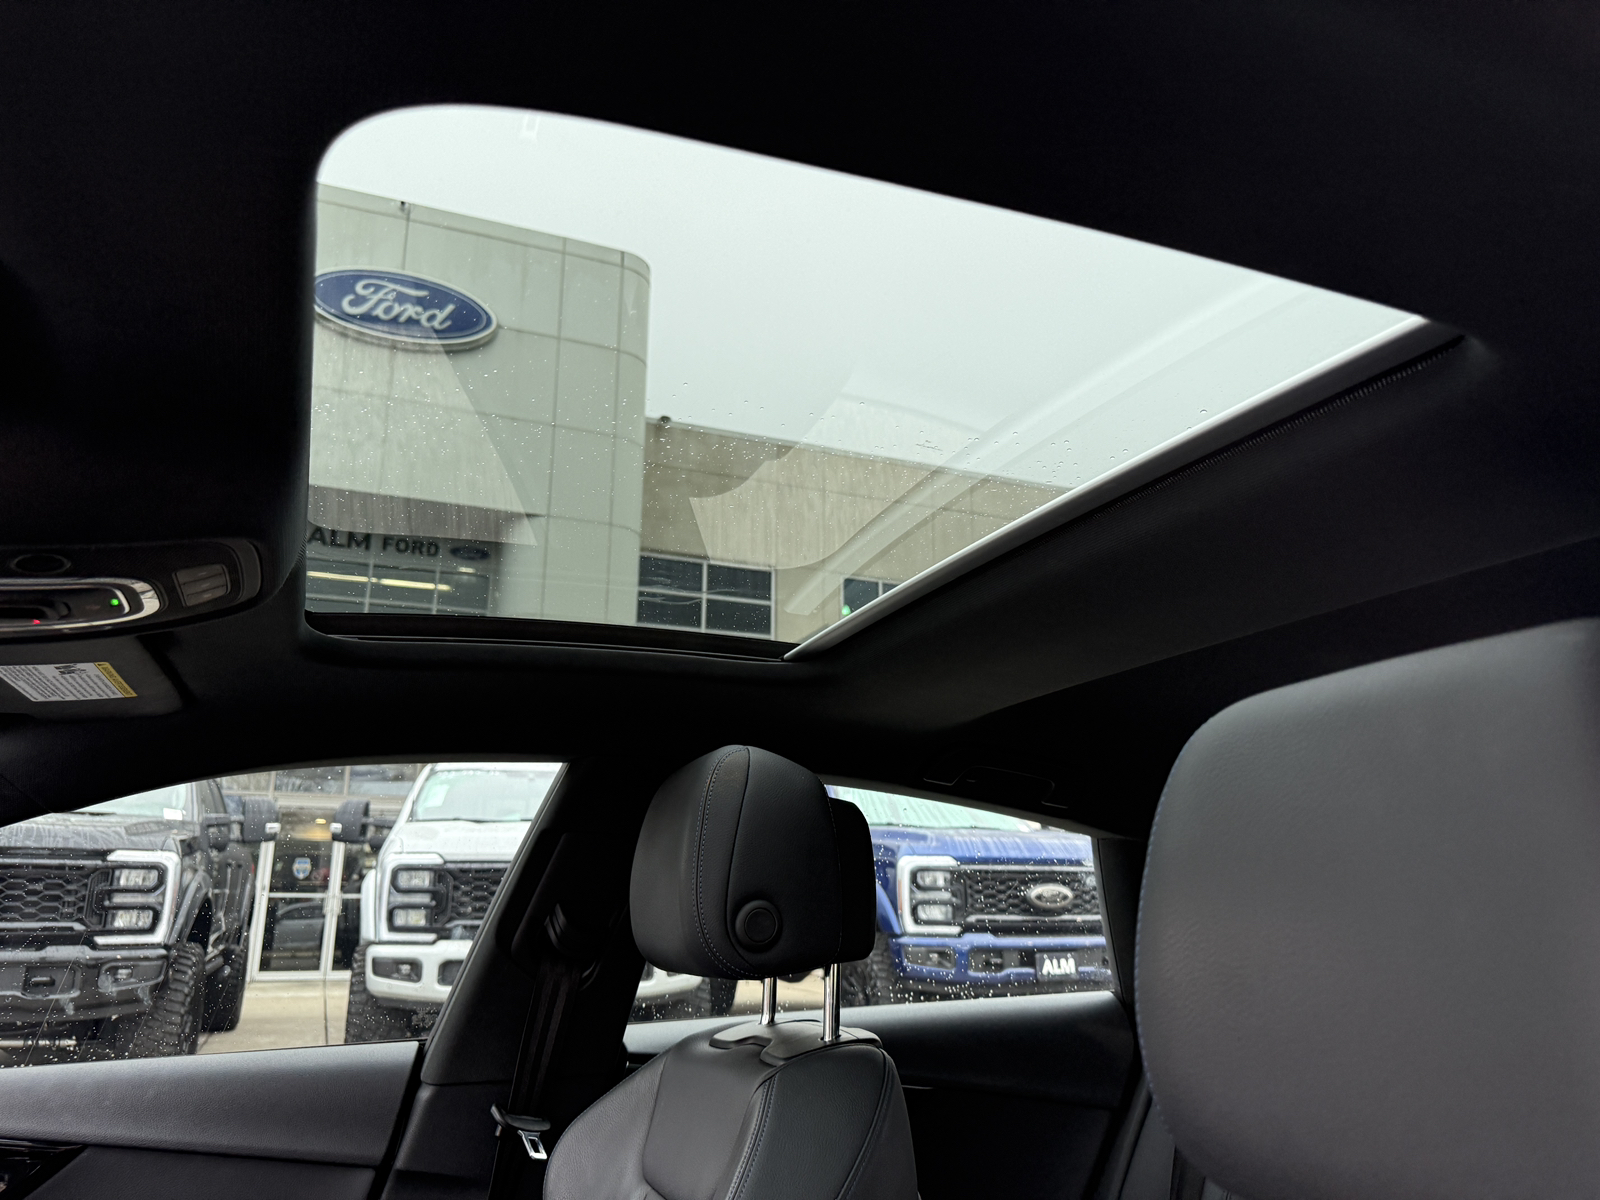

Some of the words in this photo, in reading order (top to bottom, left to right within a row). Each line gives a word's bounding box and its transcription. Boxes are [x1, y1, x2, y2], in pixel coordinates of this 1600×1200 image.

[342, 279, 456, 330] Ford
[307, 527, 371, 551] ALM
[382, 536, 441, 557] FORD
[1042, 958, 1076, 975] ALM
